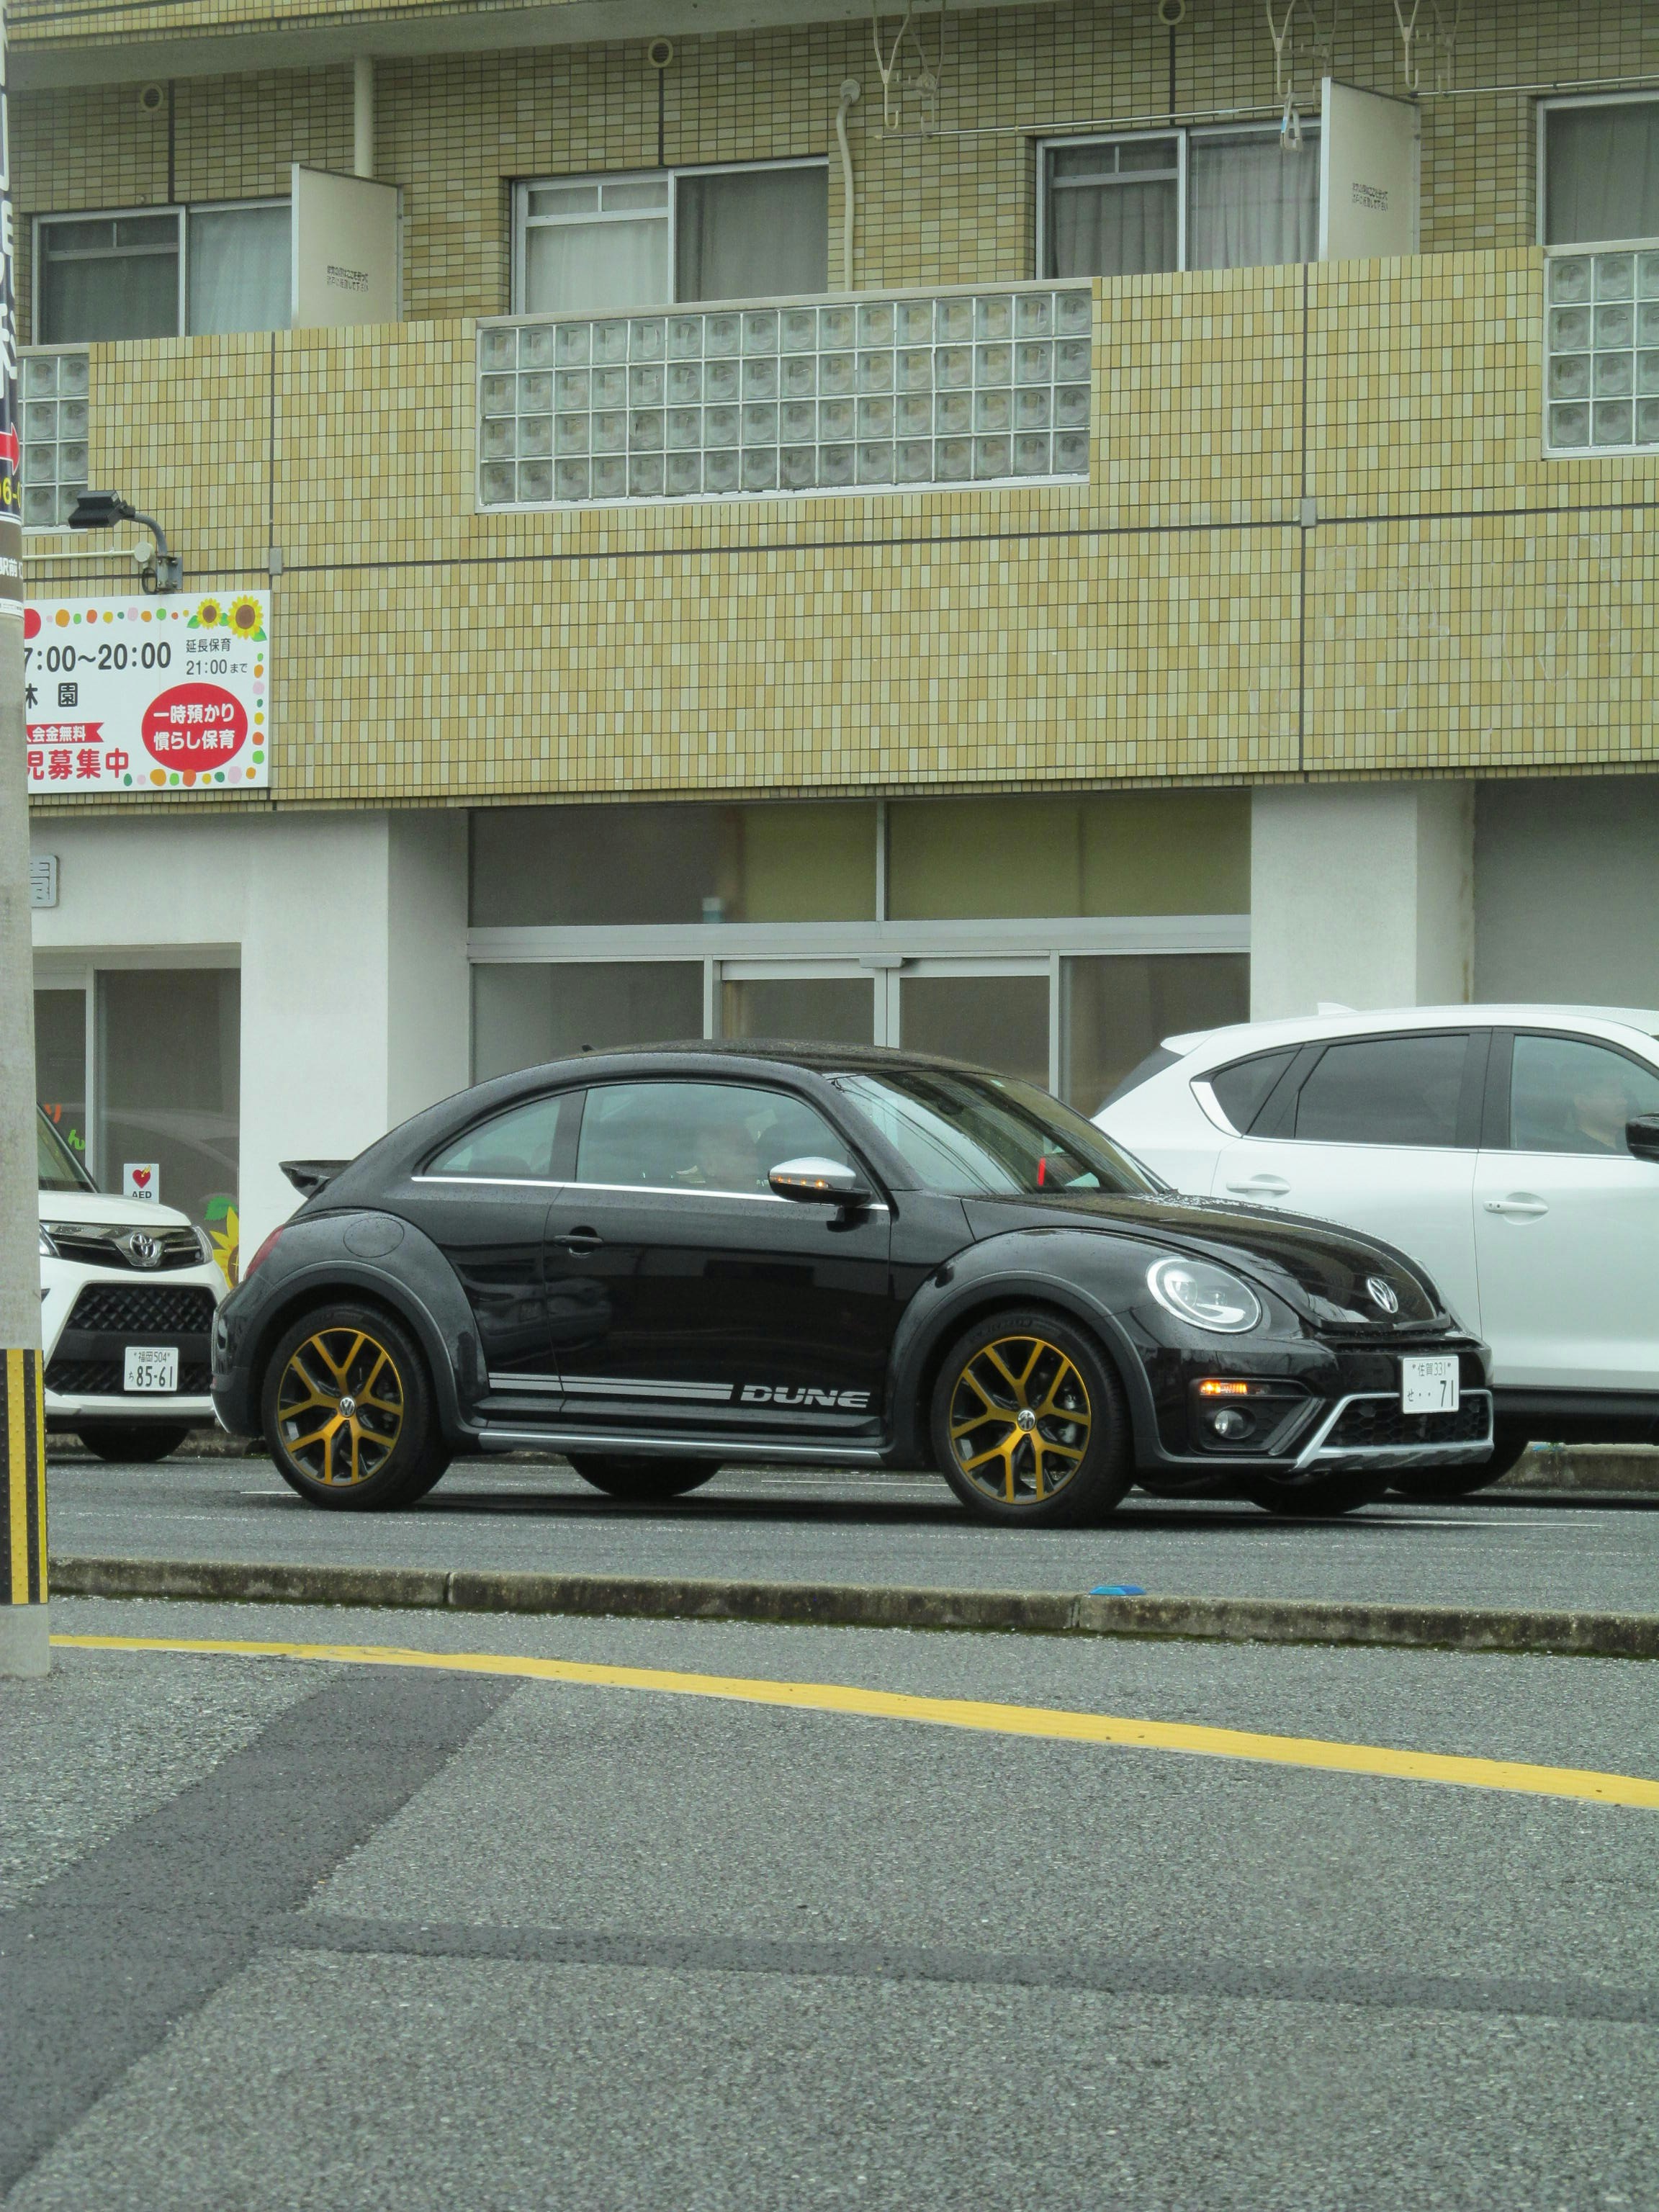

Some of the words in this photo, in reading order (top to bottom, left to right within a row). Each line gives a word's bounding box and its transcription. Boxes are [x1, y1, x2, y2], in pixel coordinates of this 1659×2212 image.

[186, 638, 231, 652] 延長保育
[153, 703, 235, 724] 一時預かり
[27, 725, 86, 742] 会金無料
[154, 729, 235, 750] 慣らし保育
[132, 1190, 152, 1199] AED
[136, 1365, 173, 1388] 85-61
[740, 1385, 871, 1408] DUNE
